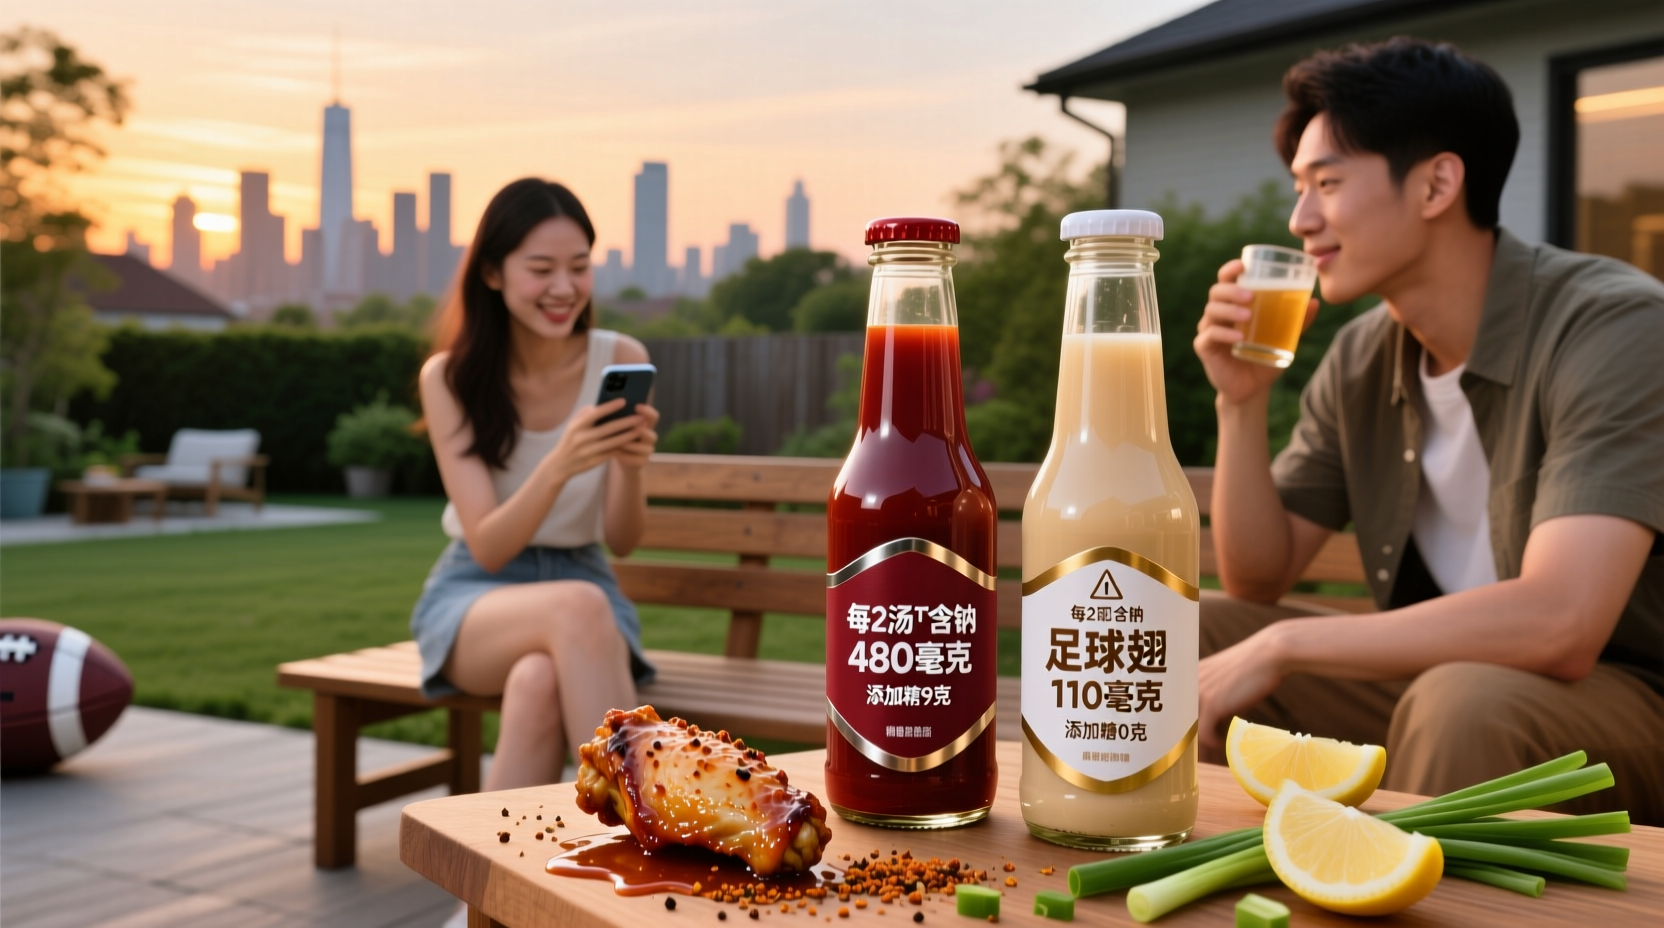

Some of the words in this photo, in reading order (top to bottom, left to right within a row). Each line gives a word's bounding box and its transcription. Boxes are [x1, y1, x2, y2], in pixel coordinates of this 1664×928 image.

[848, 641, 972, 674] 480毫克
[1046, 628, 1167, 674] 足球翅
[866, 684, 952, 706] 添加糖9克
[1051, 679, 1163, 712] 110毫克
[1065, 719, 1147, 741] 添加糖0克
